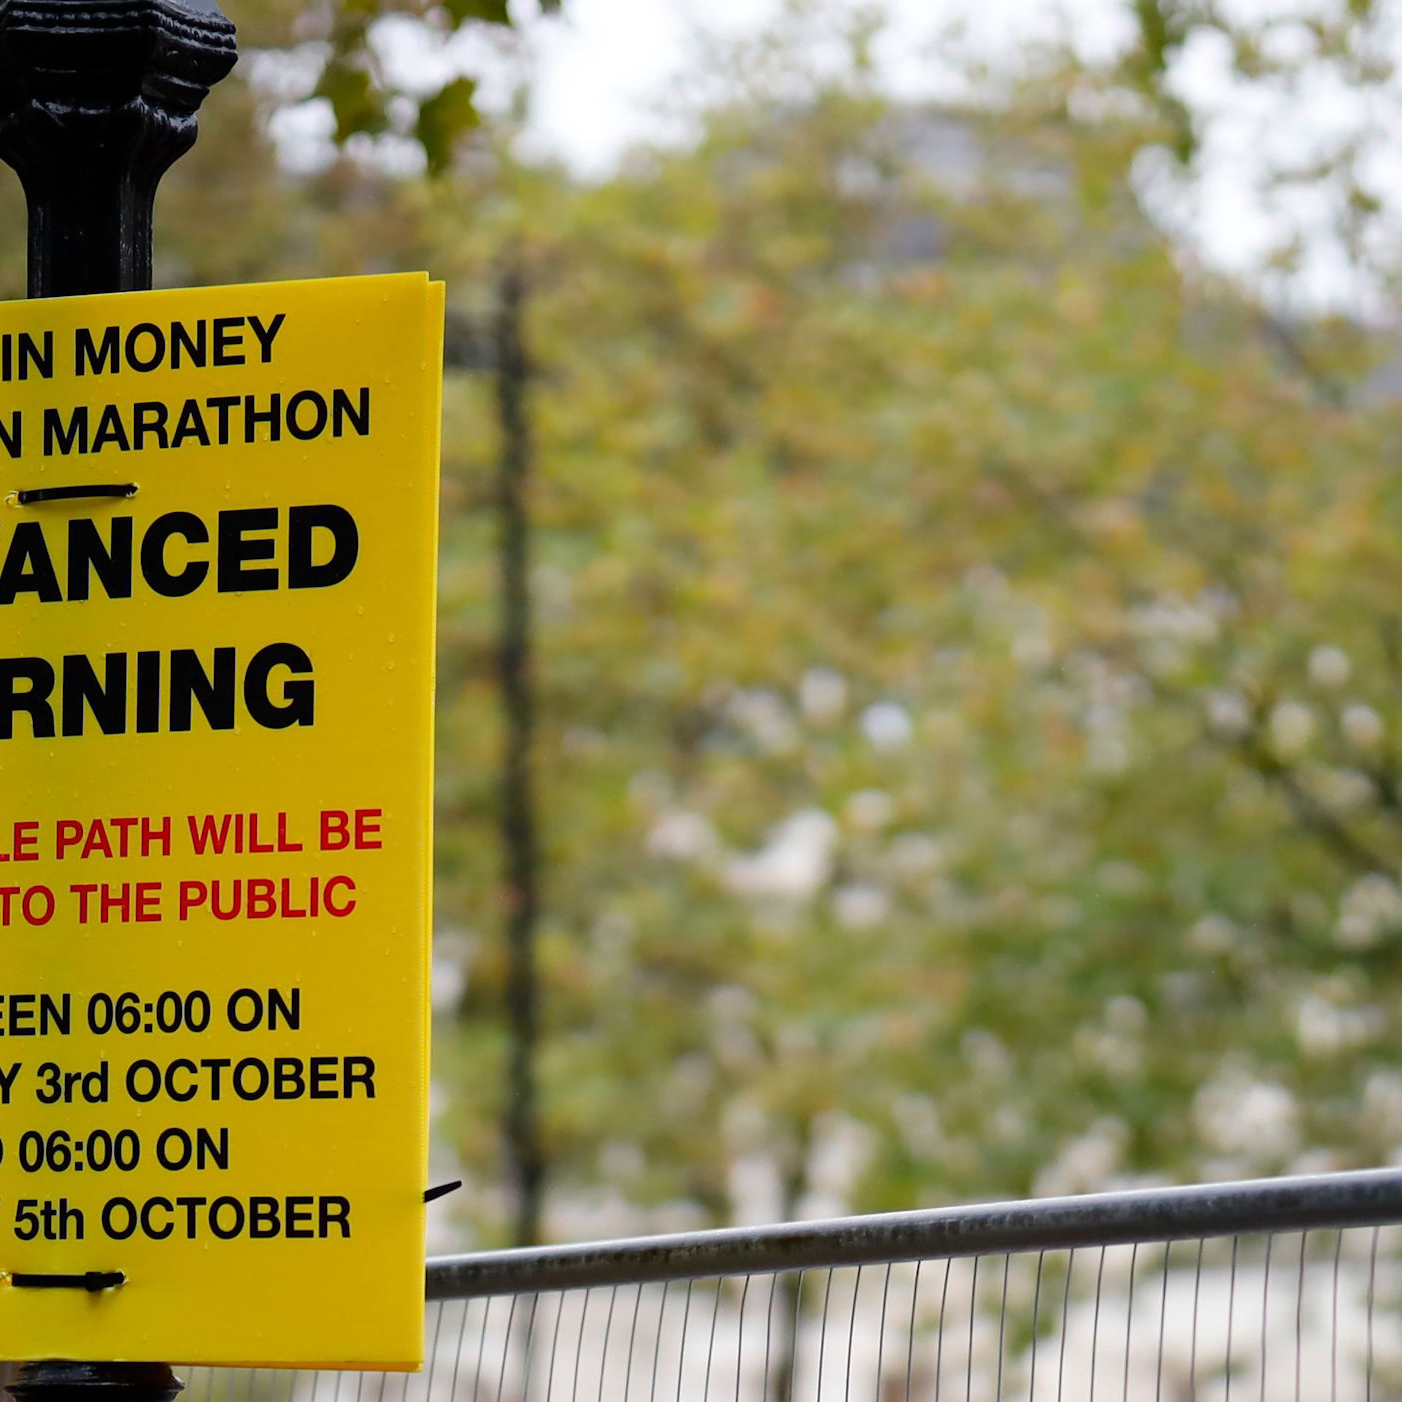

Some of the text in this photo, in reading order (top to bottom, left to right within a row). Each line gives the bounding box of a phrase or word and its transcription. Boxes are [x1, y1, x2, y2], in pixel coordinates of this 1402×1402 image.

[75, 314, 286, 376] MONEY
[44, 387, 369, 456] MARATHON
[56, 817, 171, 860] PATH
[188, 812, 303, 855] WILL
[320, 809, 382, 850] BE
[70, 882, 162, 924] THE
[180, 875, 356, 921] PUBLIC
[88, 990, 210, 1034] 06:00
[227, 988, 299, 1031] ON
[36, 1060, 108, 1104] 3rd
[126, 1056, 375, 1102] OCTOBER
[19, 1129, 140, 1172] 06:00
[157, 1128, 228, 1171] ON
[14, 1199, 84, 1240] 5th
[102, 1196, 350, 1240] OCTOBER
